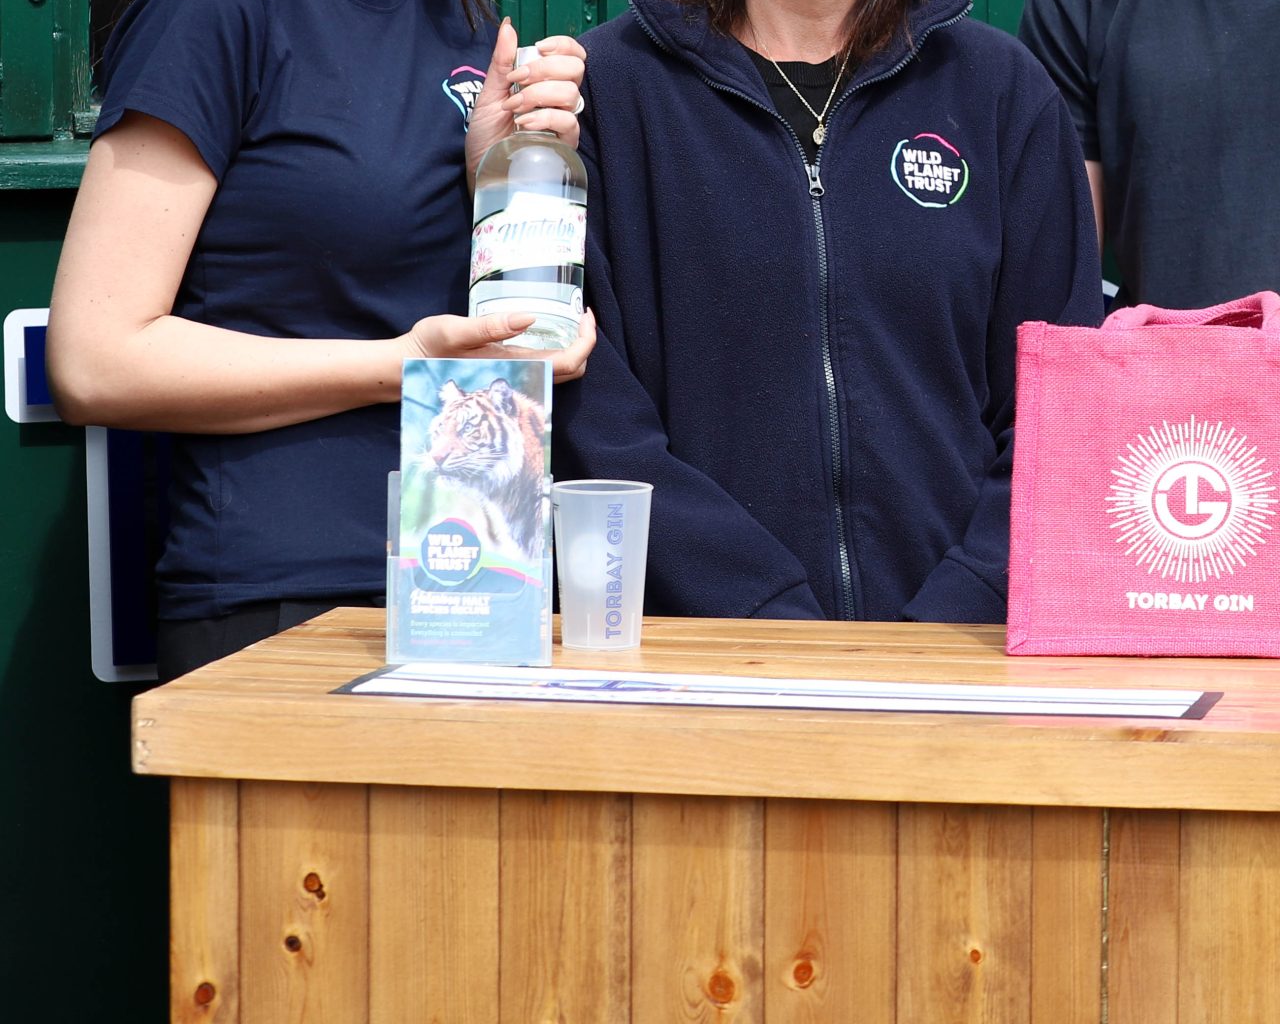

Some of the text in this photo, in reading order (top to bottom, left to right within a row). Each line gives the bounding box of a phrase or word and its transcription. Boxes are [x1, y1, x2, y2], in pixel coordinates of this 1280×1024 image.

[902, 148, 942, 165] WILD
[903, 162, 961, 182] PLANET
[904, 175, 952, 194] TRUST
[427, 534, 464, 547] WILD
[428, 546, 480, 559] PLANET
[427, 558, 472, 571] TRUST
[605, 503, 624, 639] TORBAY GIN
[1126, 591, 1254, 612] TORBAY GIN
